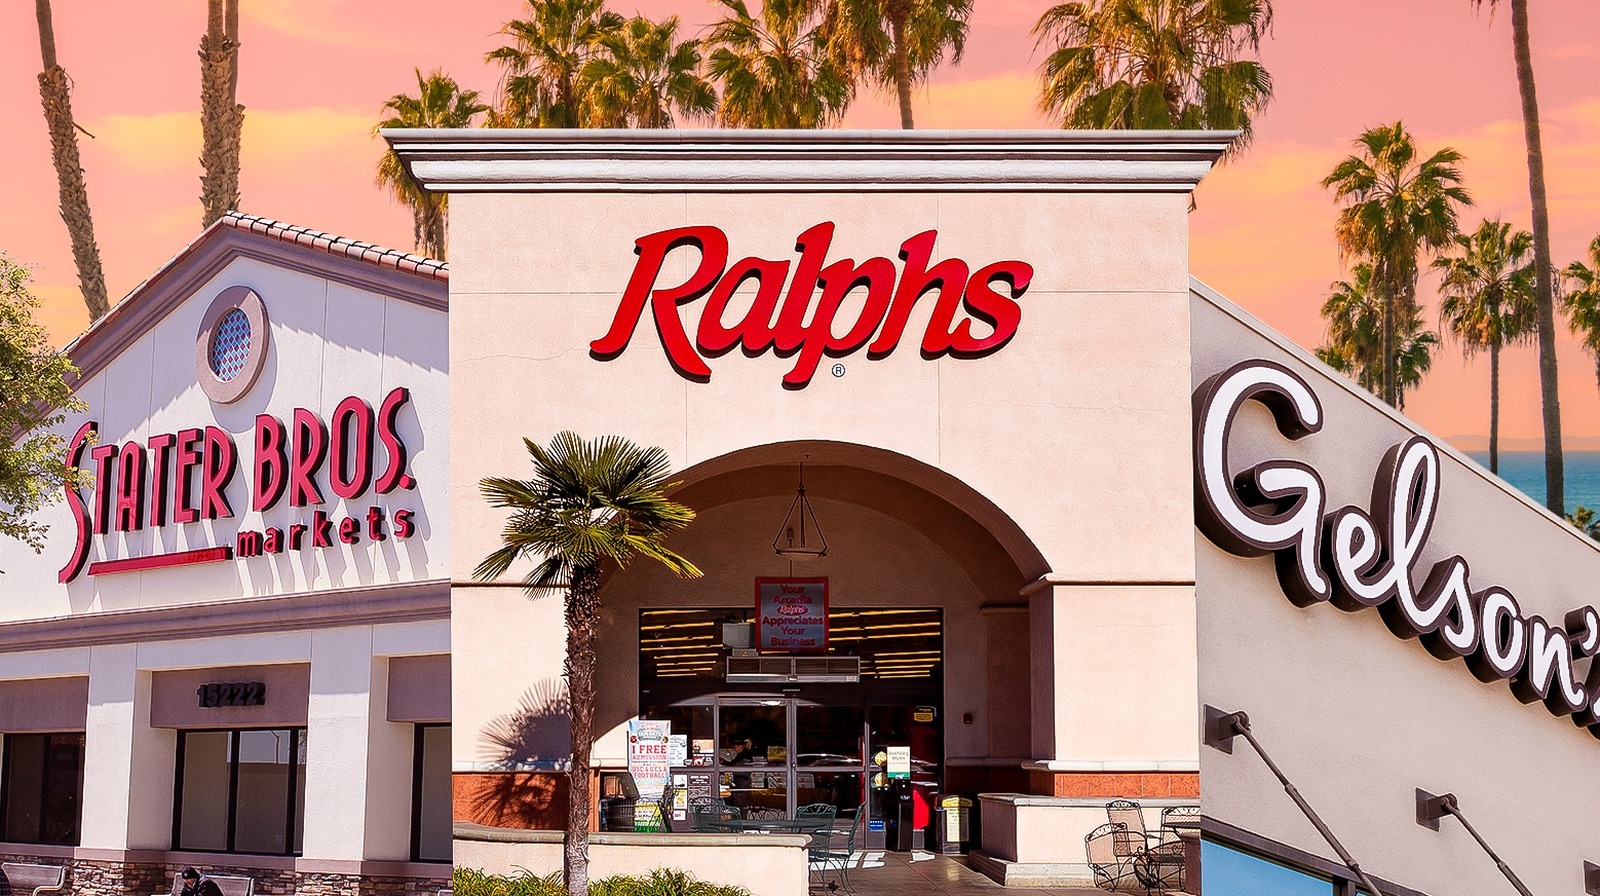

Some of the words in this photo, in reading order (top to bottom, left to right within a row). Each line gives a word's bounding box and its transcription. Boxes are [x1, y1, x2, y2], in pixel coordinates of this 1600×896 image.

[589, 220, 1034, 391] Ralphs
[58, 420, 238, 584] STATER
[252, 386, 418, 512] BROS.
[236, 505, 416, 558] markets
[1191, 359, 1600, 740] Gelson'
[780, 585, 805, 594] Your
[772, 595, 812, 604] Arcadia
[779, 605, 805, 615] Ralphs
[762, 616, 823, 627] Appreciates
[781, 626, 805, 635] Your
[771, 636, 815, 646] Business
[197, 681, 266, 708] 15222
[639, 745, 667, 754] FREE
